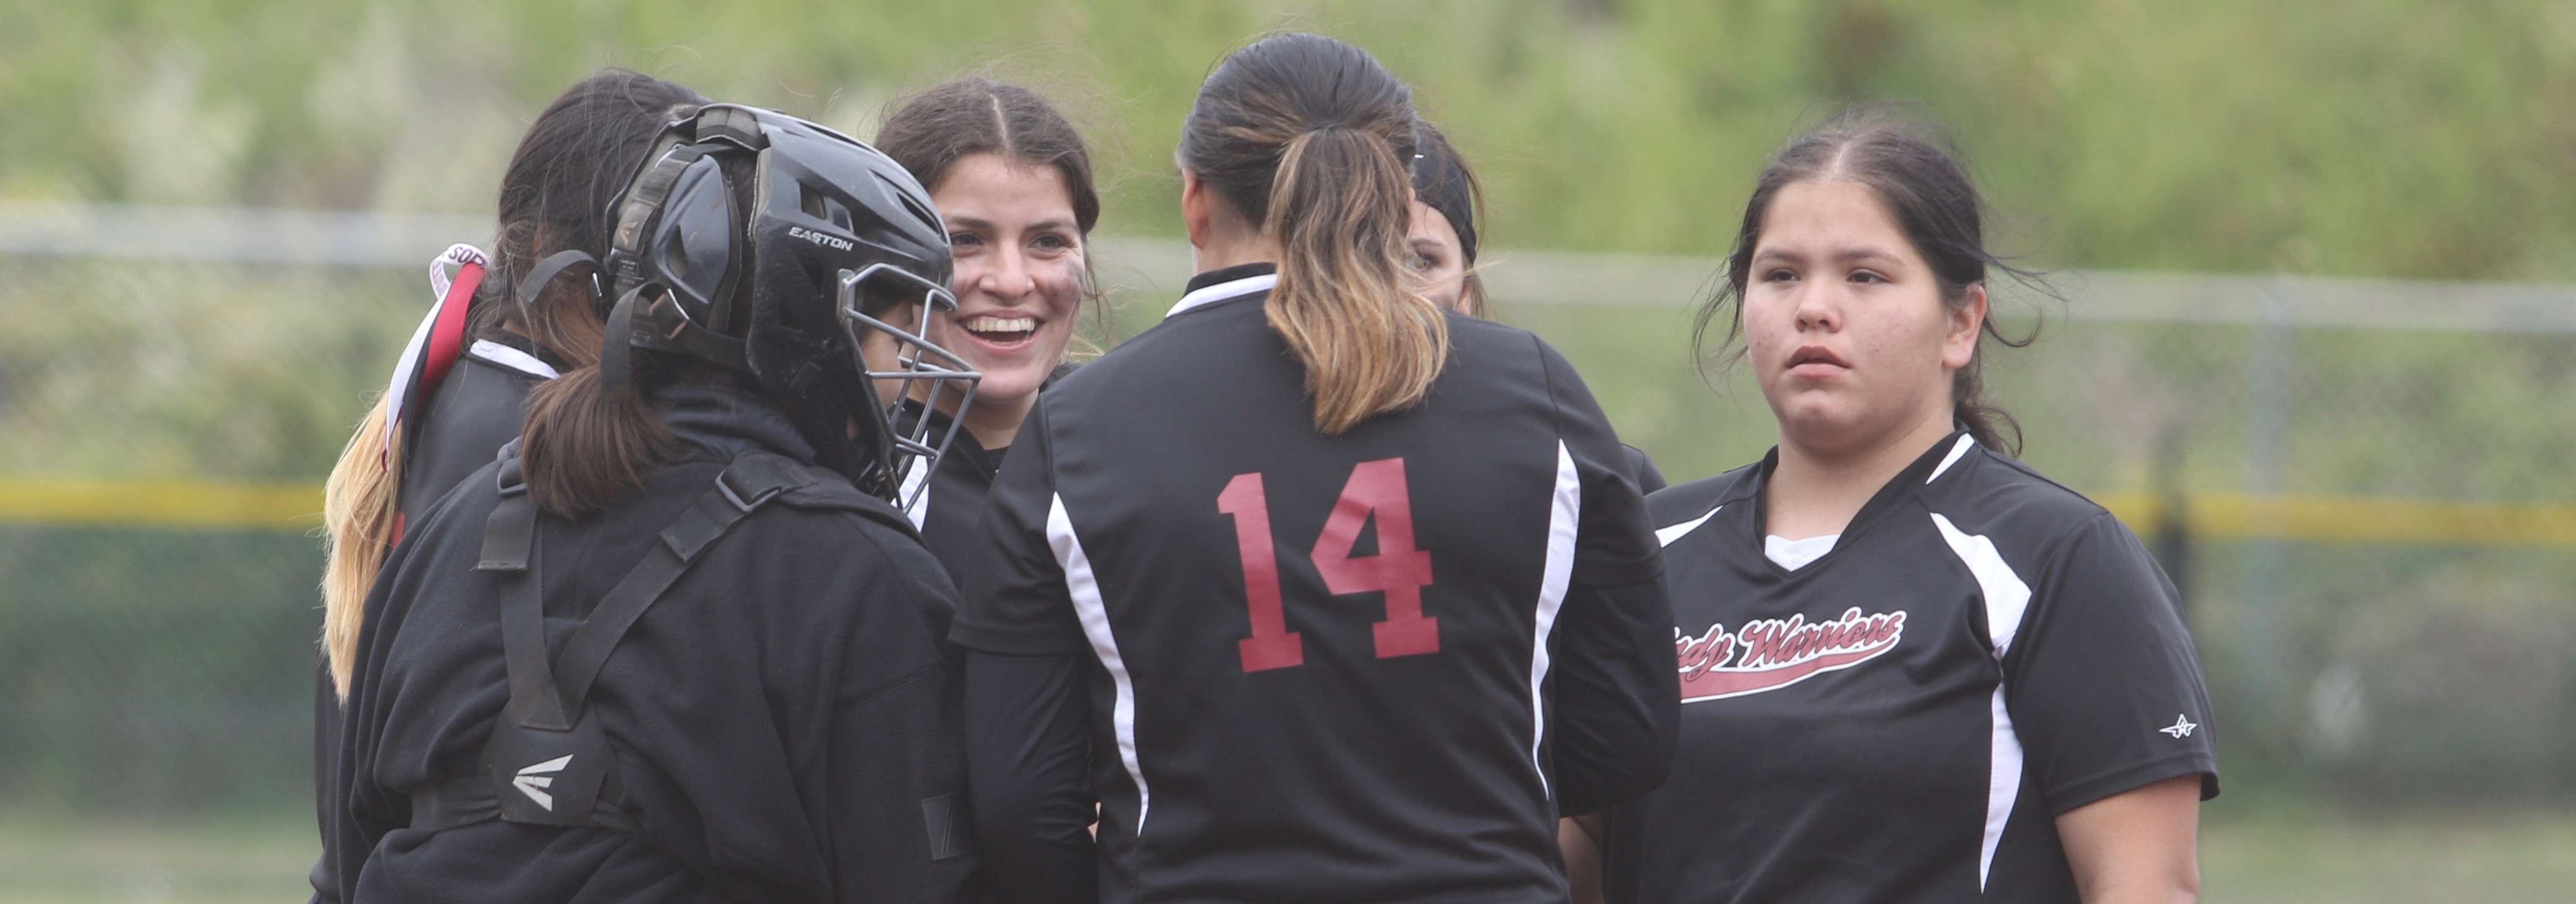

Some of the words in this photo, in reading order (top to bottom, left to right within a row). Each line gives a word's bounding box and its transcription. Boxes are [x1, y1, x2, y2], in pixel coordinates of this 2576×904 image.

[788, 226, 854, 251] EASTON
[1216, 457, 1440, 673] 14
[1737, 606, 1907, 669] Warriors
